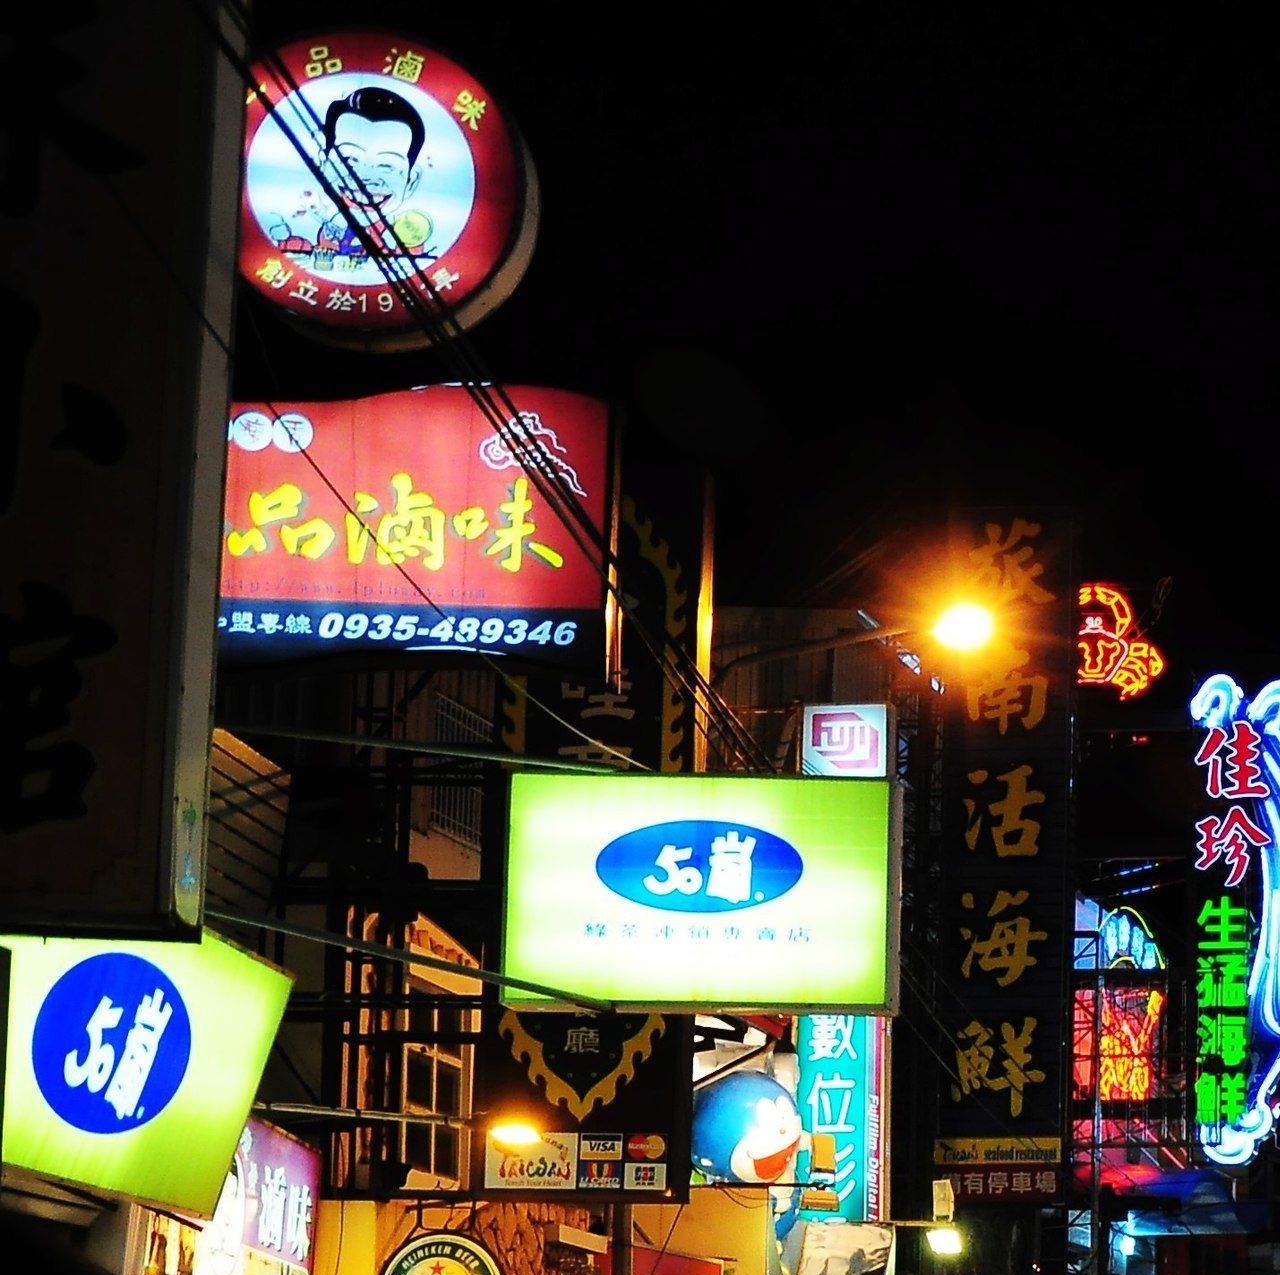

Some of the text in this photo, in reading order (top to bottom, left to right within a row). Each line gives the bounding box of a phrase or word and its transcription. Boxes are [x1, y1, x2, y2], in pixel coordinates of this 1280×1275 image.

[228, 472, 564, 572] 品滷味
[319, 612, 578, 646] 0935-489346
[1194, 719, 1272, 887] 佳珍
[643, 831, 758, 904] 50嵐
[64, 988, 173, 1118] 50嵐
[1195, 895, 1250, 1126] 生猛海鮮
[588, 1141, 616, 1153] VISA
[402, 1244, 480, 1271] HEINEKEN BEER
